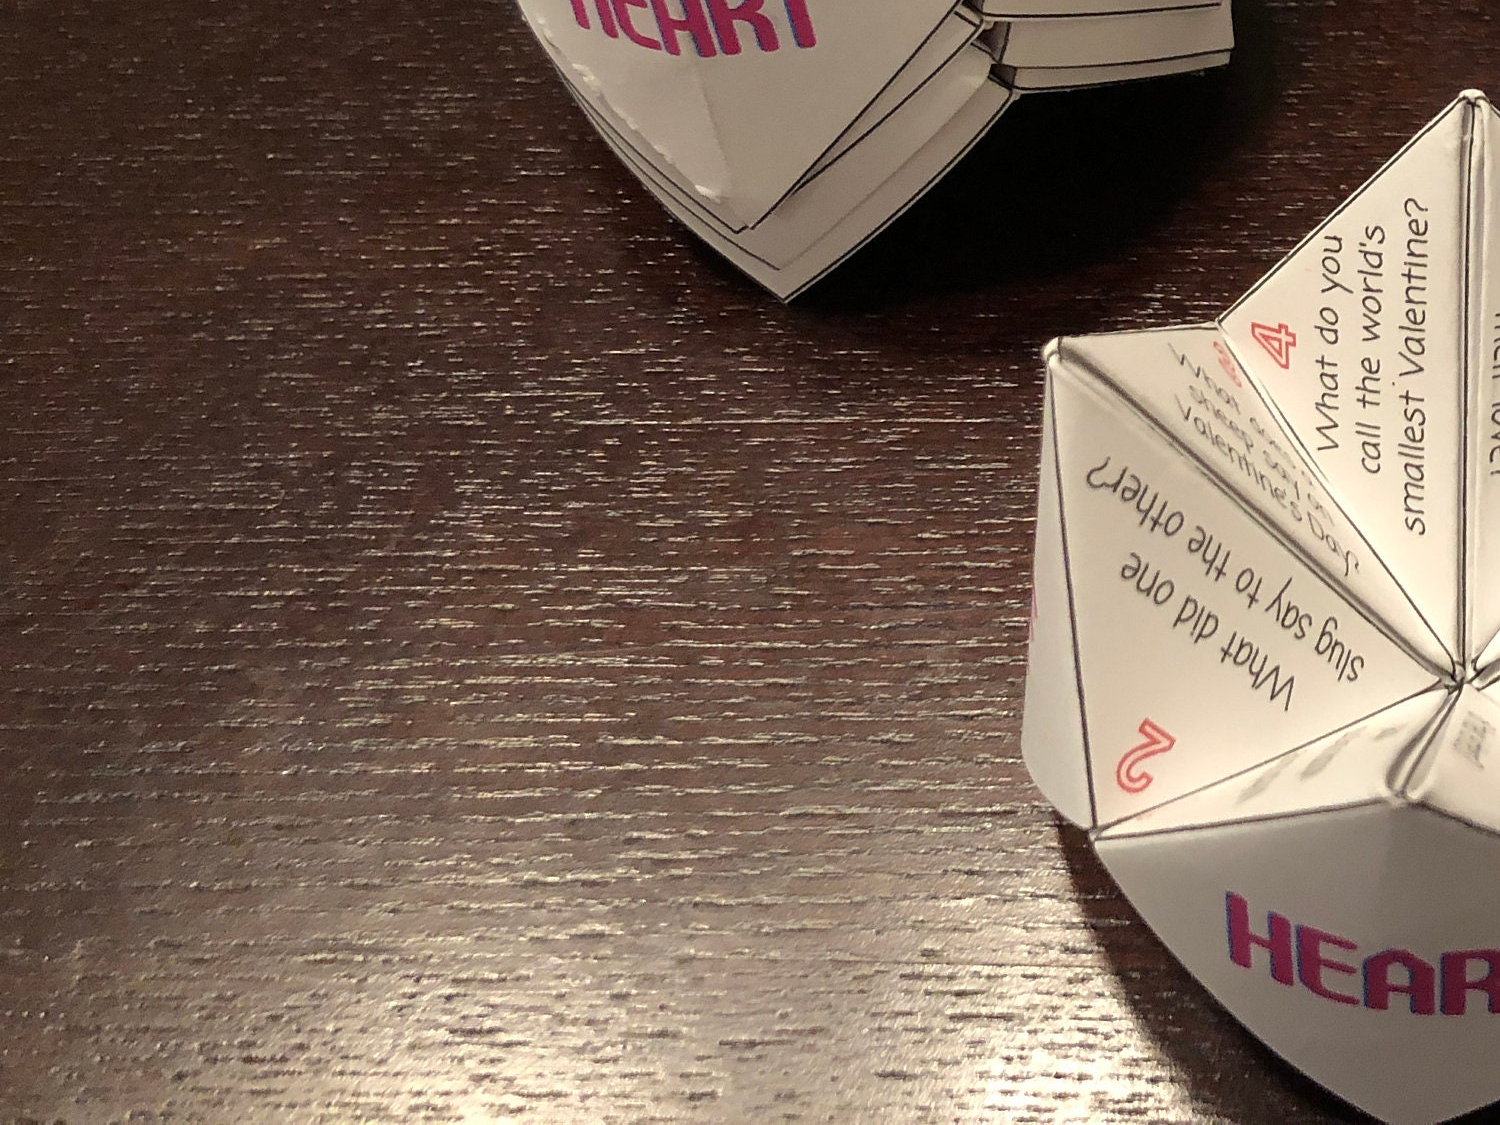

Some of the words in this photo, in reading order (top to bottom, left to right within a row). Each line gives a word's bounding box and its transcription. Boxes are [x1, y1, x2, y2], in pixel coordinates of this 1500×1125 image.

[1320, 235, 1354, 294] you
[1357, 225, 1386, 342] world's
[1398, 197, 1429, 377] Valentine?
[1251, 322, 1296, 370] 4
[1314, 306, 1340, 345] do
[1167, 342, 1241, 416] What
[1314, 354, 1340, 452] What
[1355, 356, 1381, 410] the
[1355, 421, 1381, 475] call
[1398, 389, 1426, 535] smallest
[1086, 456, 1185, 537] other?
[1120, 551, 1175, 605] one
[1187, 526, 1231, 582] the
[1173, 595, 1219, 644] did
[1235, 567, 1263, 609] to
[1265, 576, 1313, 640] say
[1220, 631, 1295, 711] What
[1314, 615, 1365, 682] slug
[1116, 717, 1176, 793] 2
